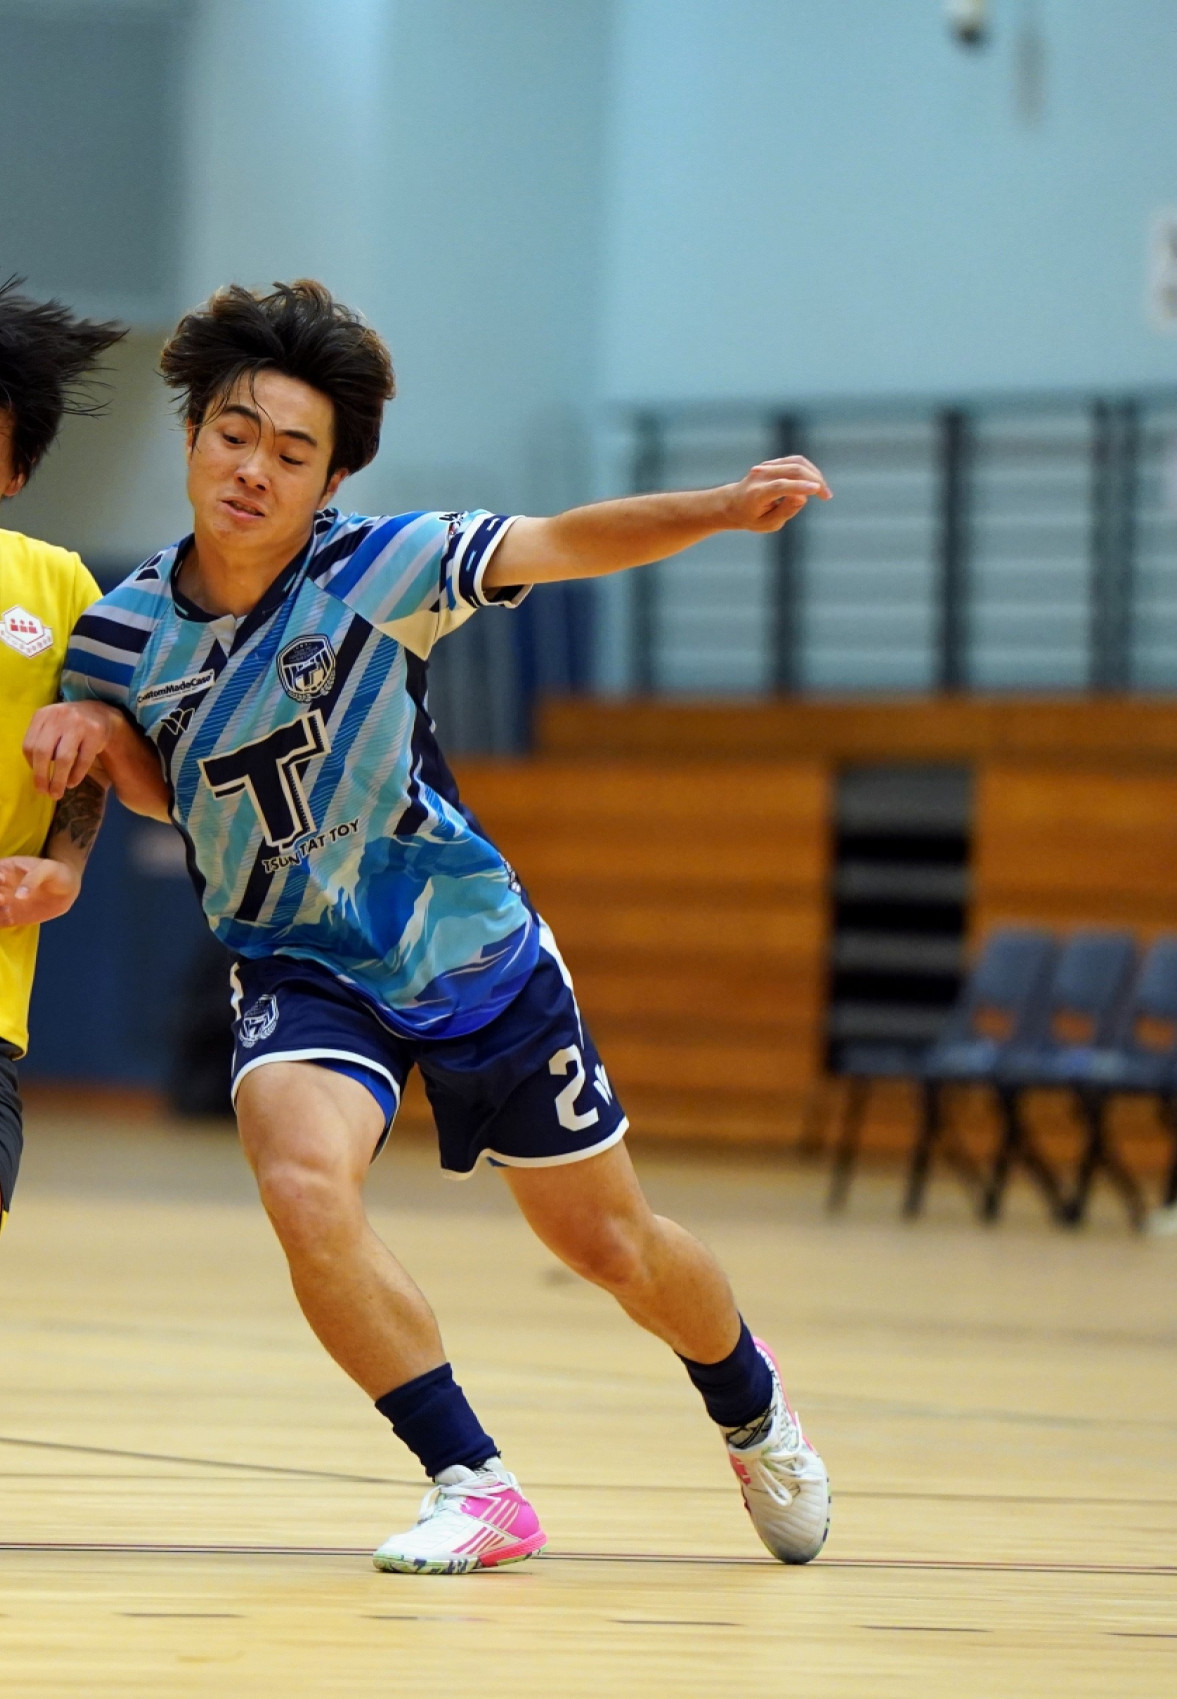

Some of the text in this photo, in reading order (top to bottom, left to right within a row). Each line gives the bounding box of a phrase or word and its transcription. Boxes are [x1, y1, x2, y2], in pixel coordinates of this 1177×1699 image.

[263, 818, 359, 873] TSUN TAT TOY
